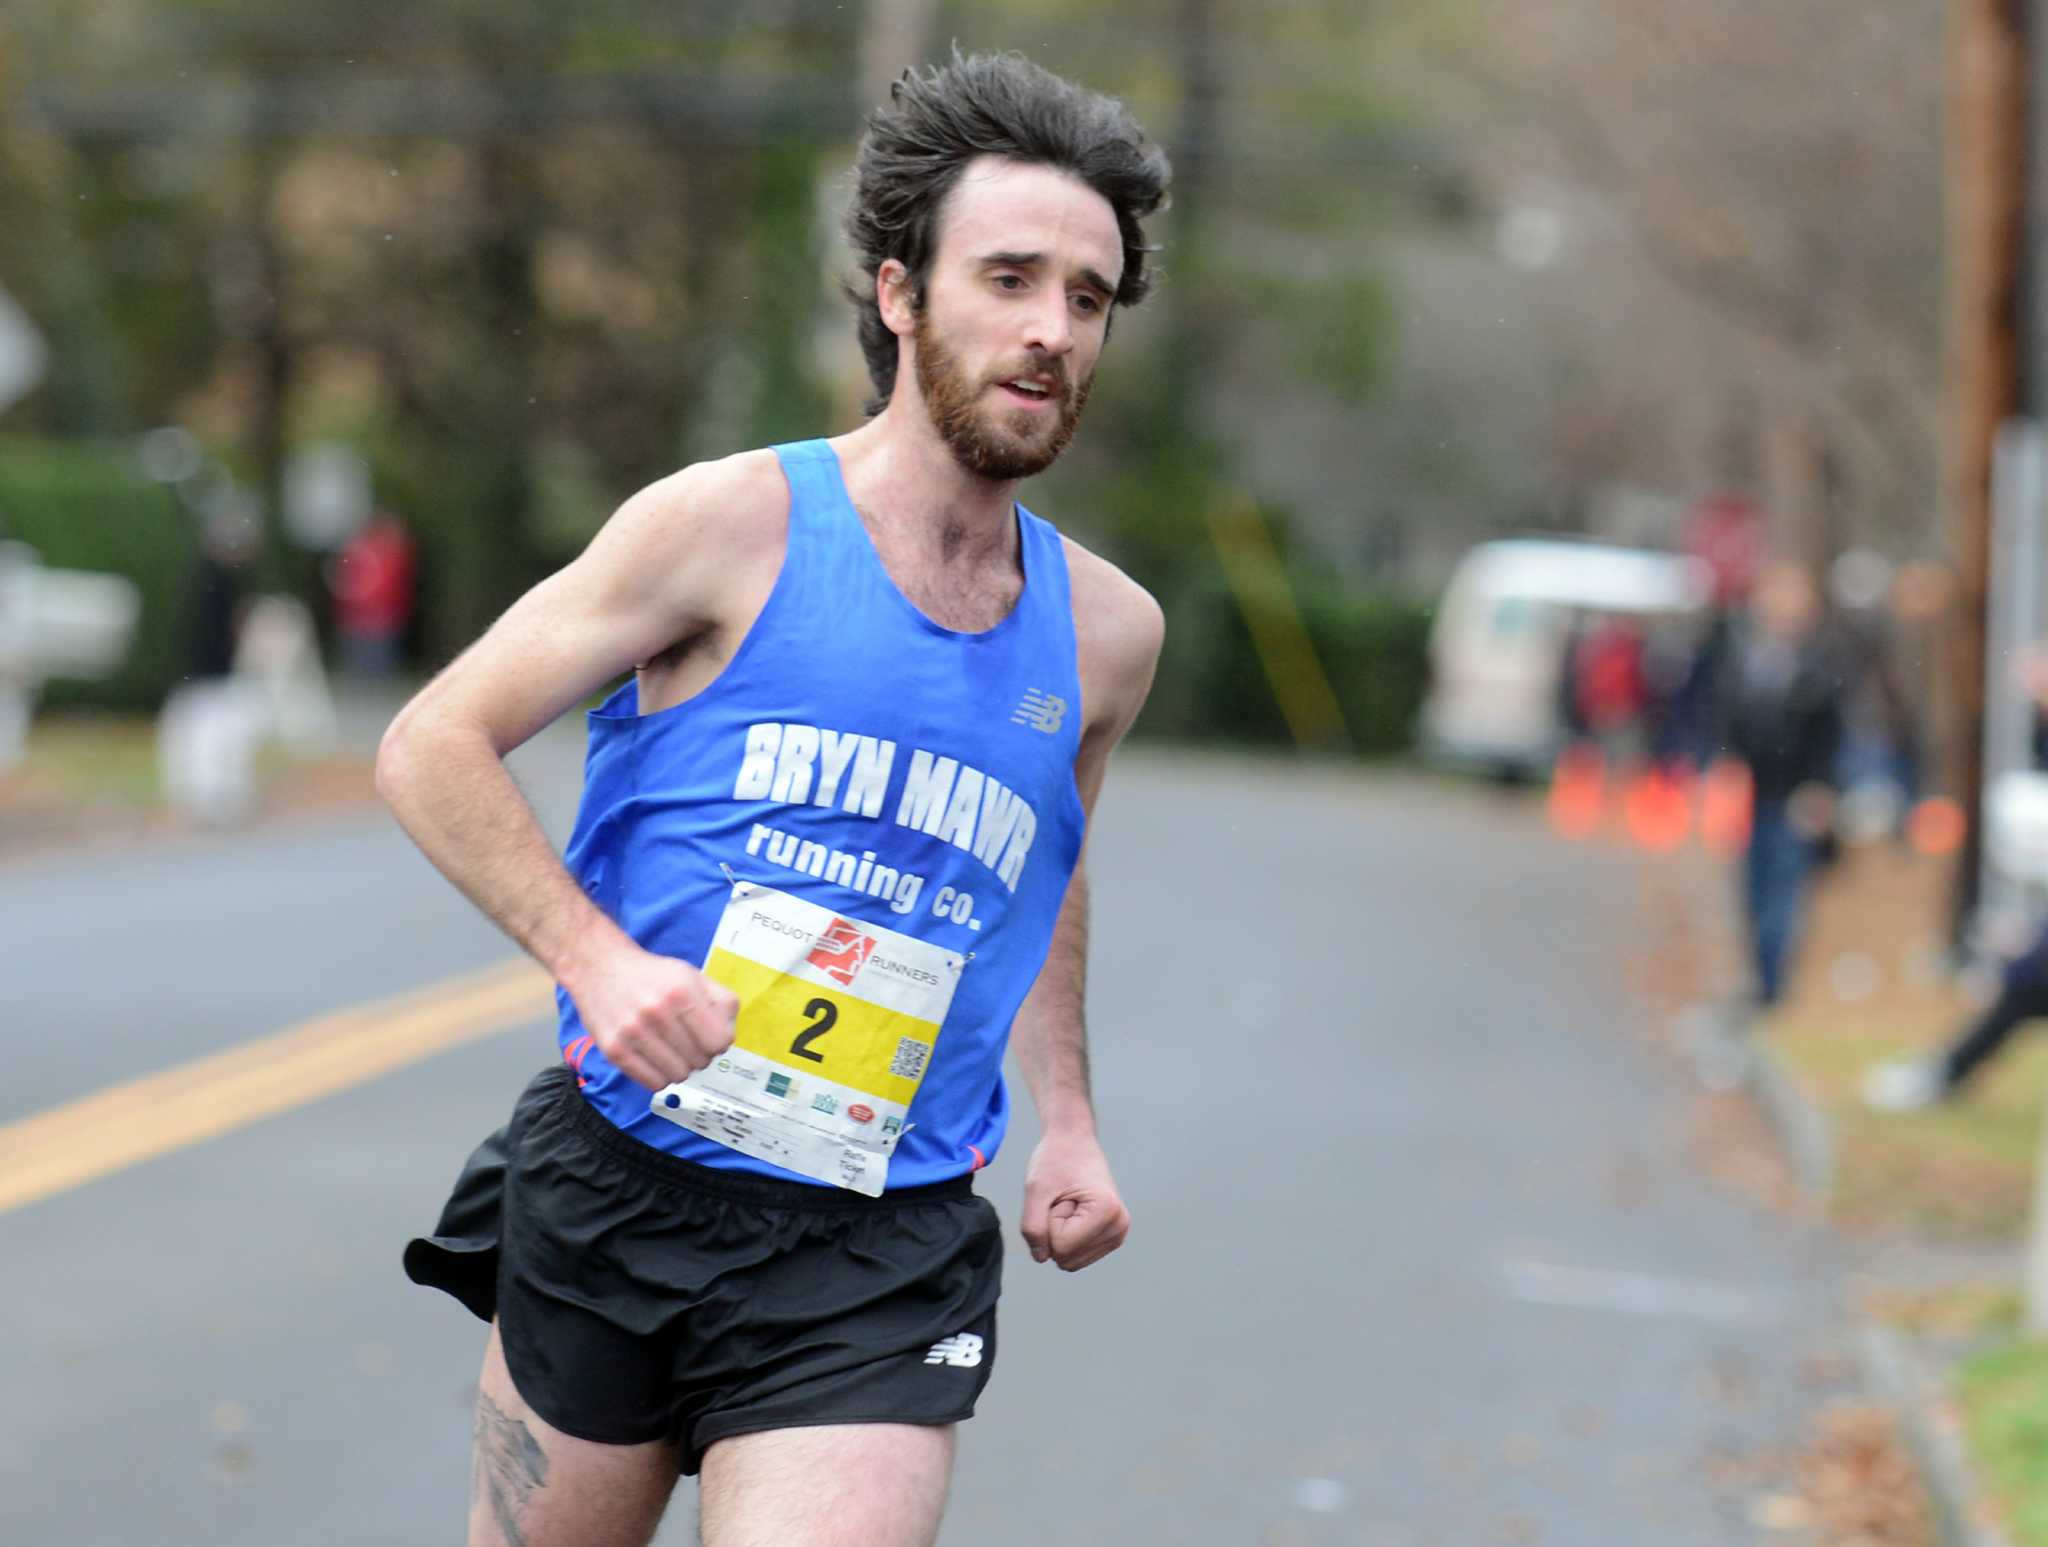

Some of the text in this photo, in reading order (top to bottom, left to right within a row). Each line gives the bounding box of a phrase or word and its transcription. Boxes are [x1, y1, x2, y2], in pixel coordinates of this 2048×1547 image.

[733, 722, 1037, 894] BRYN MAWR
[745, 823, 982, 931] running co.
[751, 911, 815, 944] PEQUOT
[870, 954, 941, 987] RUNNERS
[789, 997, 838, 1064] 2
